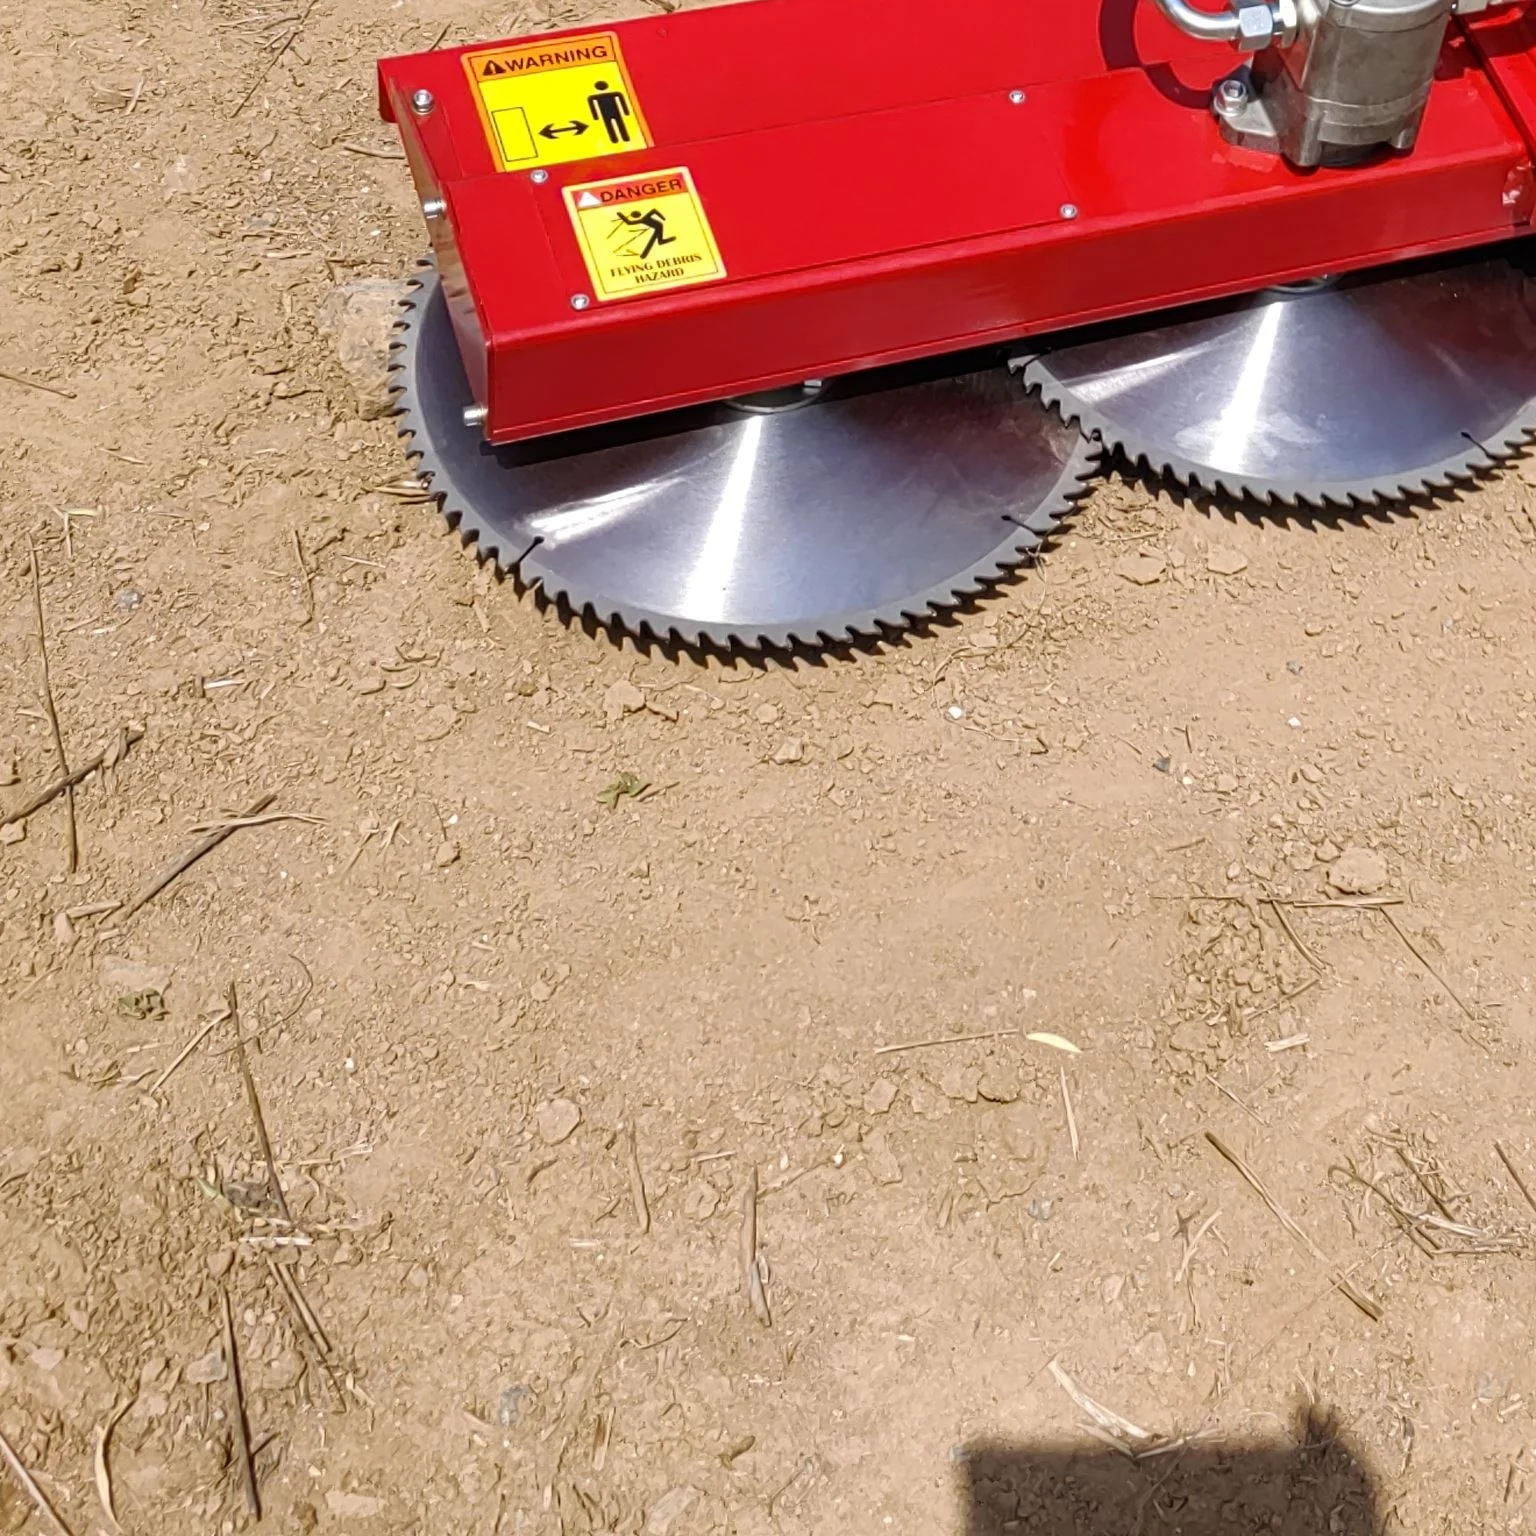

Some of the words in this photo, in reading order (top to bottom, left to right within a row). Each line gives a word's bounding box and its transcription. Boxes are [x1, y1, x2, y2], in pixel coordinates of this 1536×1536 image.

[505, 45, 607, 72] WARNING
[600, 178, 682, 203] DANGER
[610, 263, 653, 277] FLYING
[656, 253, 702, 268] DEBRIS
[635, 267, 684, 284] HAZARD
